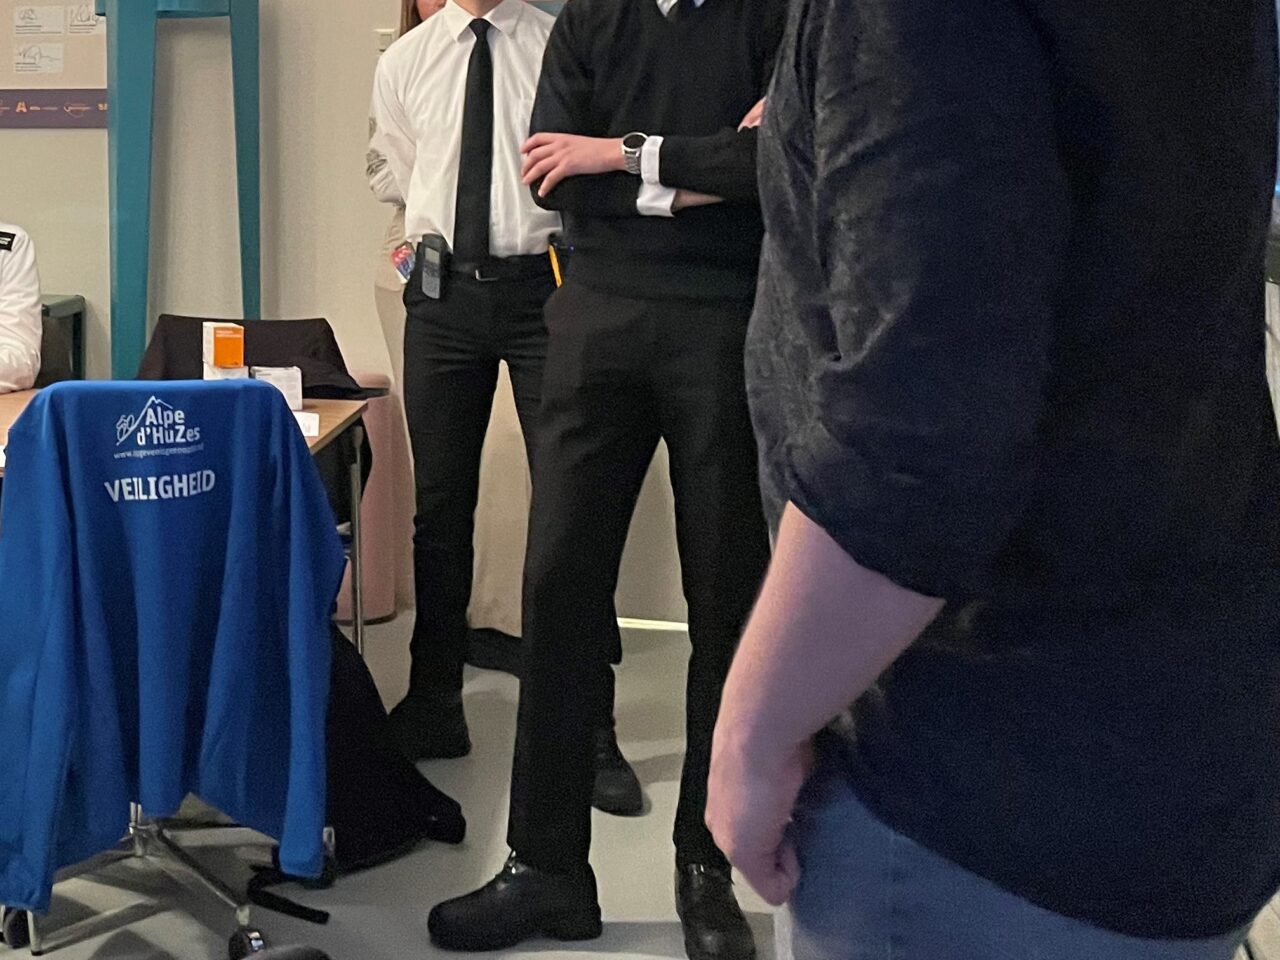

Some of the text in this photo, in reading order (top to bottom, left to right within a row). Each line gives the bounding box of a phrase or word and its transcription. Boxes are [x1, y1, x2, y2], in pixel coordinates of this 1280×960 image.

[145, 406, 185, 428] Alpe
[136, 424, 200, 446] d'HuZes
[103, 470, 216, 502] VEILIGHEID
